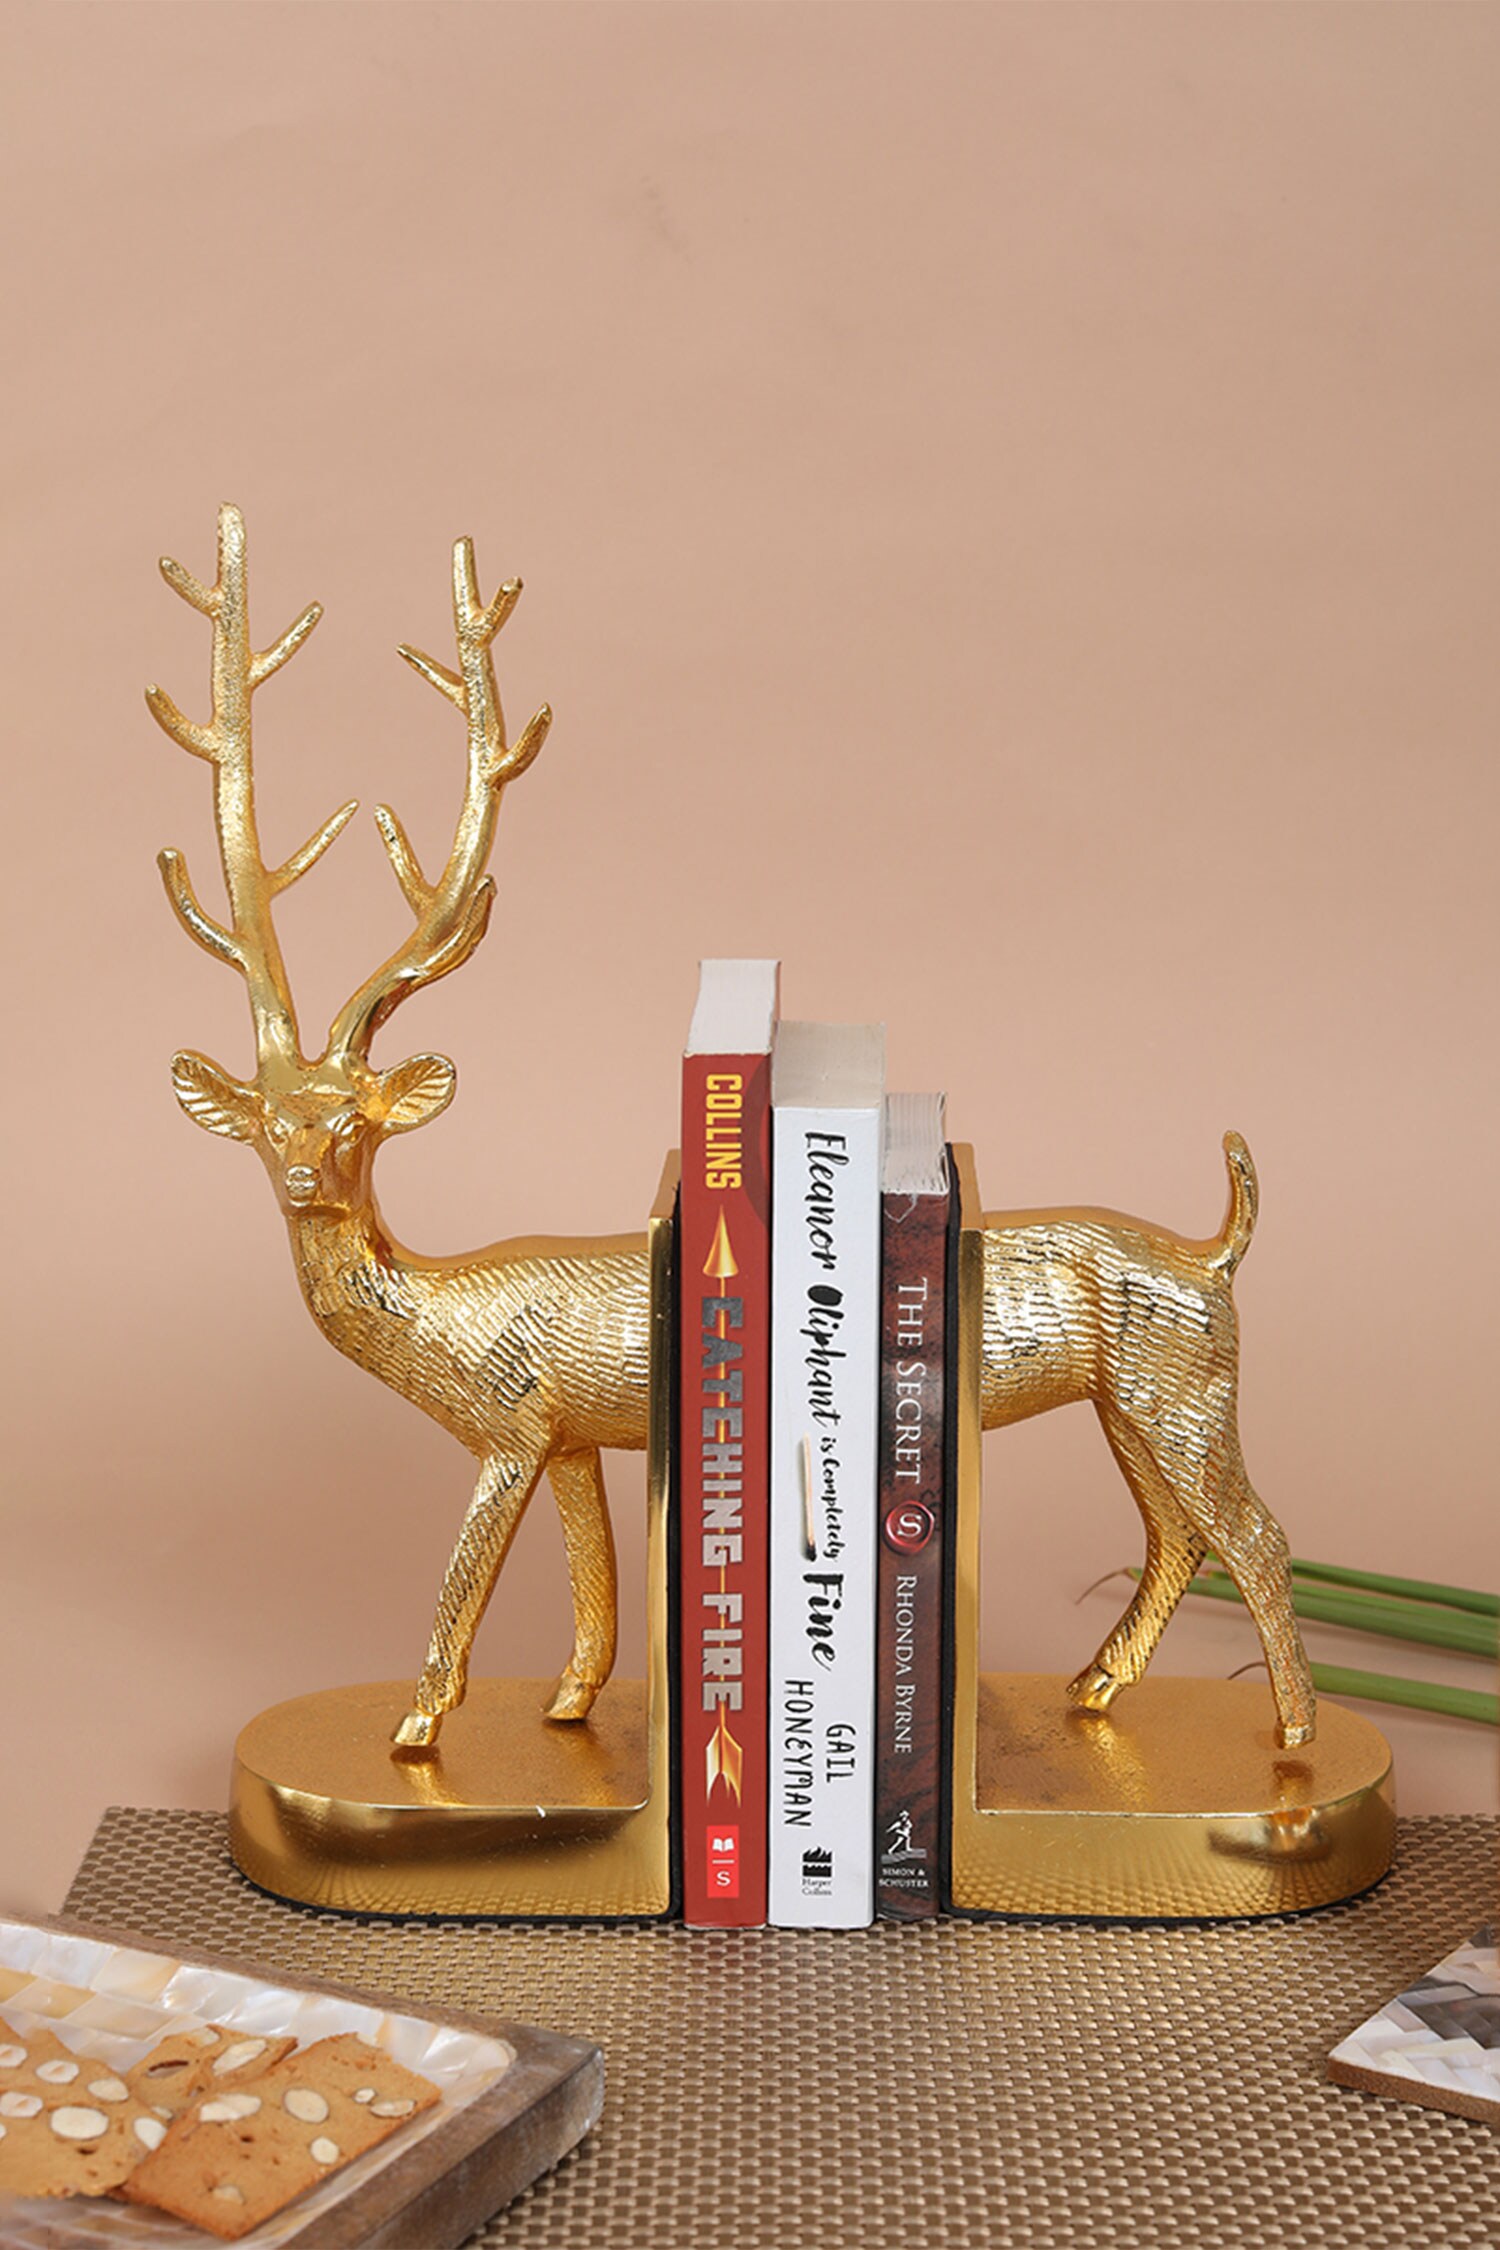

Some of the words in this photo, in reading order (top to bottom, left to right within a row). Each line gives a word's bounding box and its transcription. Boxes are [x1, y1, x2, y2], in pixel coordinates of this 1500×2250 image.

[706, 1074, 742, 1189] COLLINS
[804, 1131, 849, 1271] Eleanor
[897, 1277, 927, 1349] THE
[800, 1284, 847, 1428] Oliphant
[702, 1297, 742, 1566] CATCHING
[820, 1437, 837, 1454] is
[896, 1361, 926, 1484] SECRET
[702, 1594, 743, 1711] FIRE
[803, 1573, 843, 1672] Fine
[895, 1576, 917, 1677] RHONDA
[783, 1680, 814, 1827] HONEYMAN
[826, 1723, 856, 1783] GAIL
[895, 1684, 916, 1754] BYRNE
[716, 1870, 731, 1886] S
[802, 1878, 832, 1888] Harper
[802, 1887, 832, 1897] Collins
[879, 1877, 928, 1888] SCHUSTER
[882, 1867, 916, 1876] SIMON
[918, 1867, 925, 1876] &
